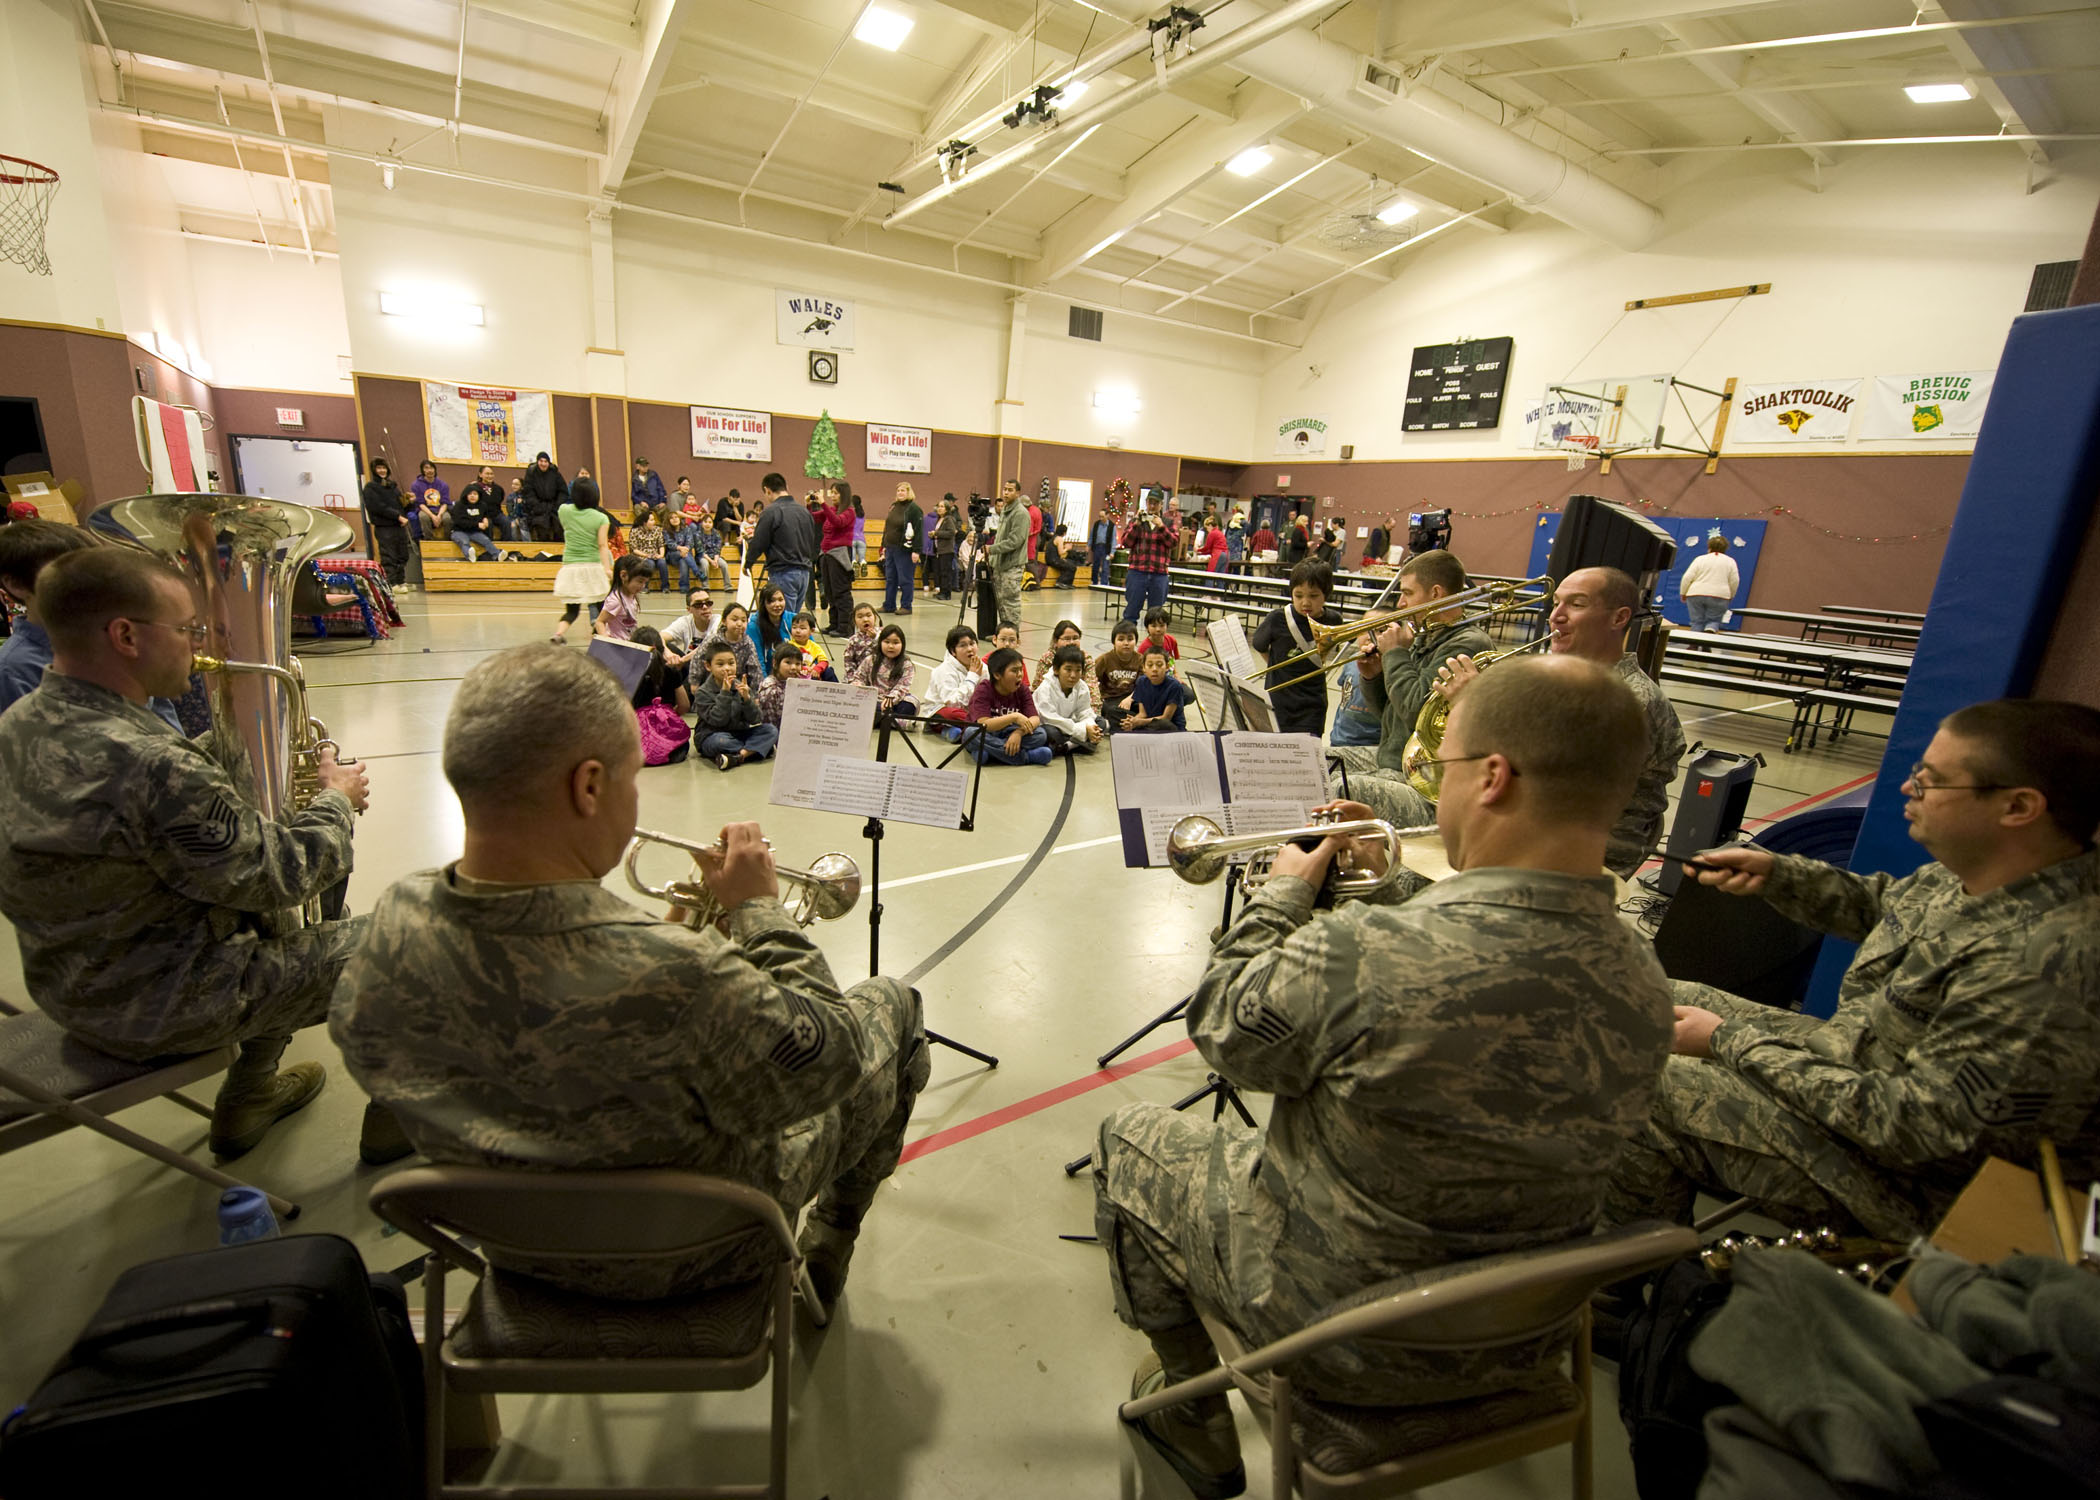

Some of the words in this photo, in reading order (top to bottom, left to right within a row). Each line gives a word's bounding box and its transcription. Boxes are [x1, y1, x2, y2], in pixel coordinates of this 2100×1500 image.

[788, 298, 843, 320] WALES
[1414, 368, 1434, 377] HOME
[1476, 362, 1500, 371] GUEST
[1910, 376, 1972, 391] BREVIG
[1744, 388, 1854, 416] SHAKTOOLIK
[1902, 390, 1970, 404] MISSION
[479, 401, 492, 410] Be
[477, 410, 506, 419] Buddy
[1526, 403, 1555, 424] WHTE
[696, 416, 718, 430] Win
[722, 418, 739, 431] For
[742, 420, 766, 434] Life!
[1280, 418, 1328, 436] SHISHMAREF
[481, 442, 500, 451] Not
[870, 432, 888, 444] Win
[892, 434, 906, 445] For
[908, 435, 928, 448] Life!
[482, 451, 508, 463] Bully
[797, 708, 828, 717] CHRISTMAS
[830, 712, 859, 720] CRACKERS
